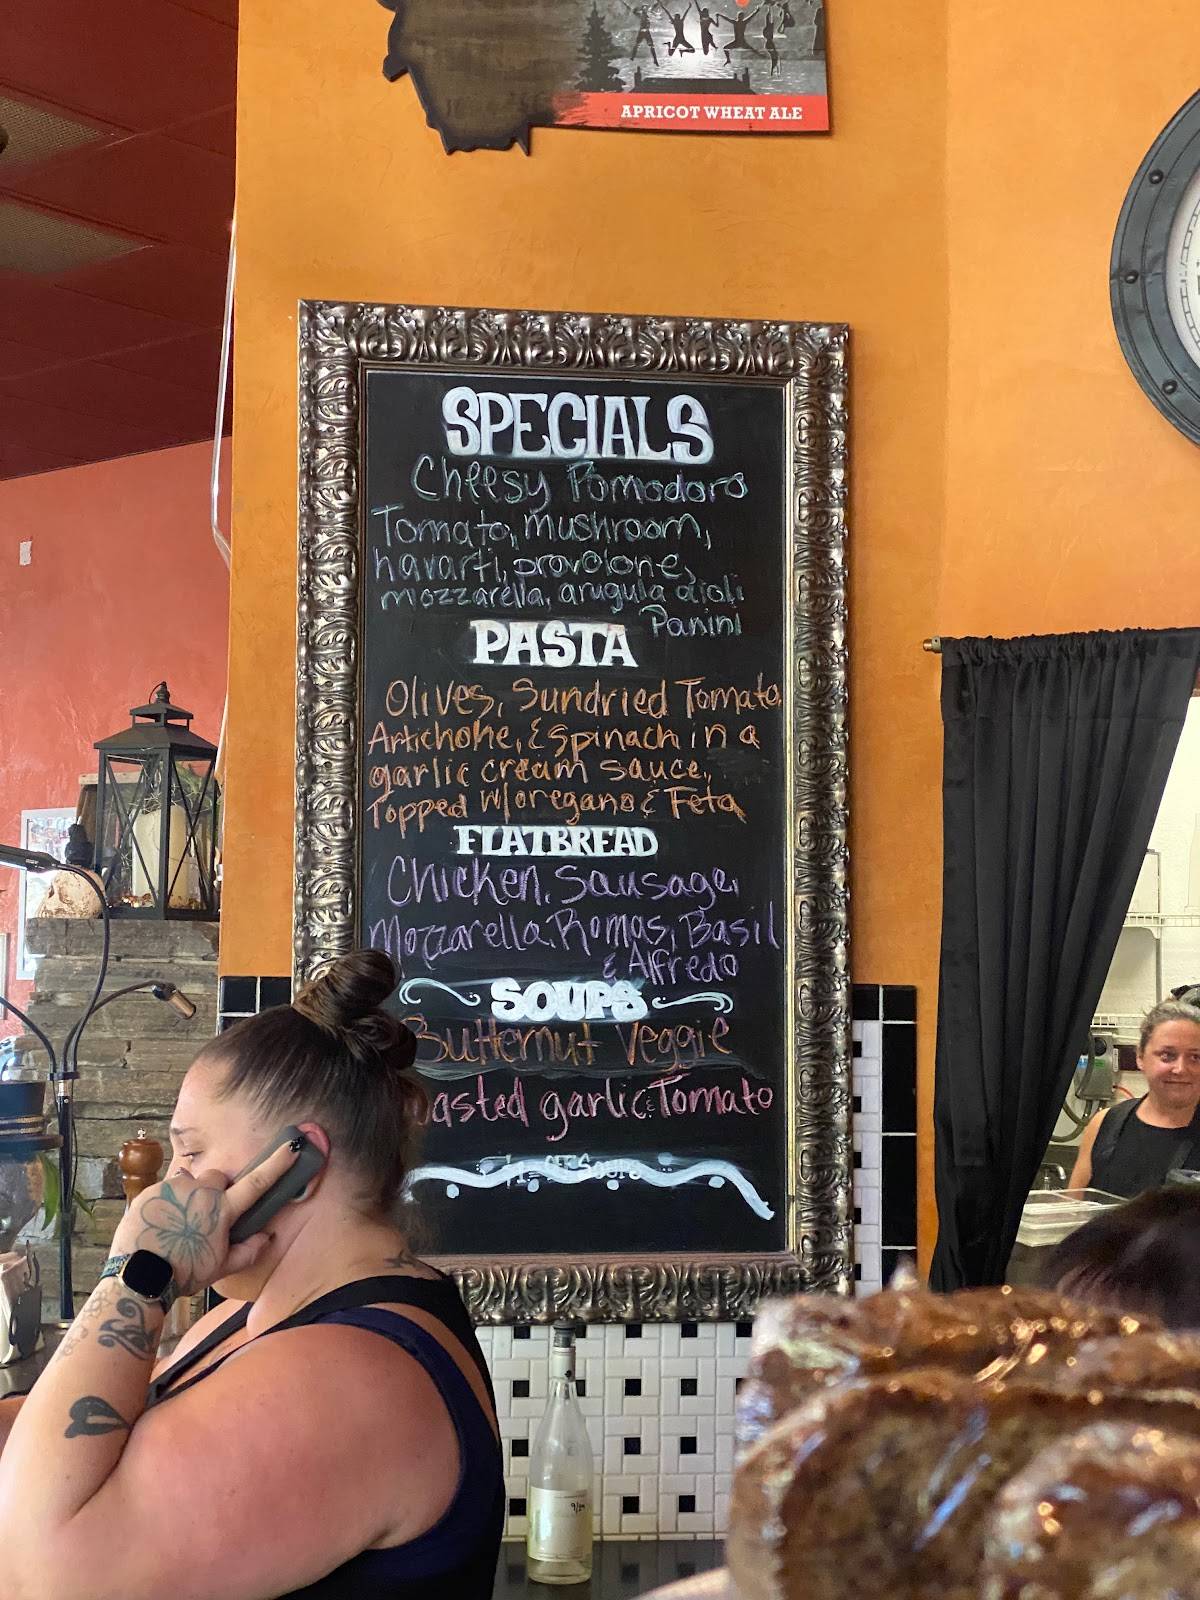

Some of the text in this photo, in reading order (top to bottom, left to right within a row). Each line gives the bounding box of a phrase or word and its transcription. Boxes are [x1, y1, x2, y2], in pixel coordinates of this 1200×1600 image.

[621, 105, 802, 120] APRICOT WHEAT ALE
[442, 386, 714, 464] SPECIALS
[411, 454, 748, 514] Cheesy Pomodoro
[371, 505, 519, 550] Tomato,
[513, 548, 697, 586] provolone,
[560, 579, 666, 614] arugula
[676, 573, 745, 603] aioli
[639, 604, 742, 638] Panini
[469, 620, 639, 668] PASTA
[386, 675, 504, 719] Olives,
[512, 677, 667, 719] Sundried
[691, 722, 727, 749] in
[739, 724, 760, 749] a
[369, 756, 469, 791] garlic
[481, 757, 589, 784] cream
[366, 789, 468, 839] Topped
[454, 825, 659, 857] FLATBREAD
[679, 901, 780, 949] Basil
[629, 941, 738, 985] Alfredo
[490, 976, 648, 1021] SOUPS
[401, 1014, 732, 1073] Butternut Veggie
[421, 1074, 529, 1128] asted
[541, 1078, 646, 1141] garlic
[648, 1072, 774, 1120] Tomato
